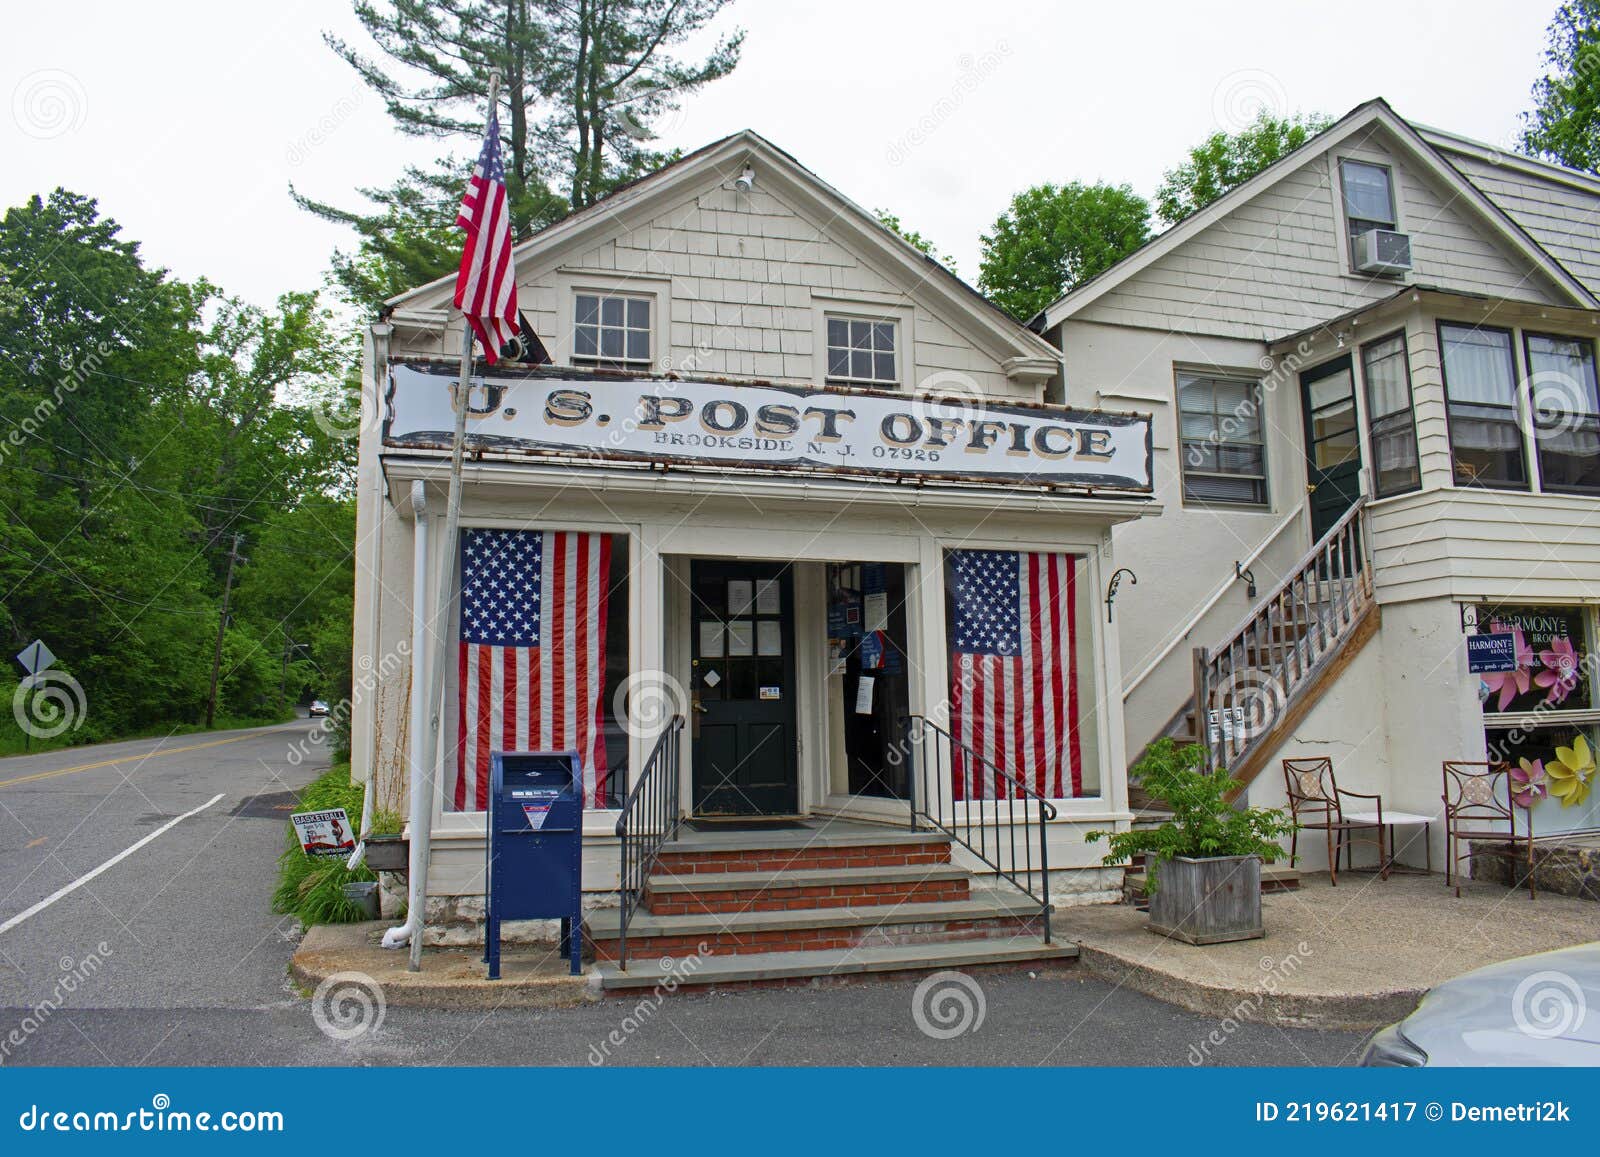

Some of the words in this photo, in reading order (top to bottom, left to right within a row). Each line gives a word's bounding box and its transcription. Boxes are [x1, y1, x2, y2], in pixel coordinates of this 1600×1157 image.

[447, 381, 518, 420] U.
[543, 389, 611, 427] S.
[636, 394, 857, 444] POST
[879, 412, 1117, 463] OFFICE
[653, 432, 794, 453] BROOKSIDE
[807, 441, 827, 455] N.
[871, 446, 940, 463] 07926
[1495, 615, 1560, 633] HARMONY
[1469, 640, 1508, 650] HARMONY
[294, 811, 345, 824] BASKETBALL
